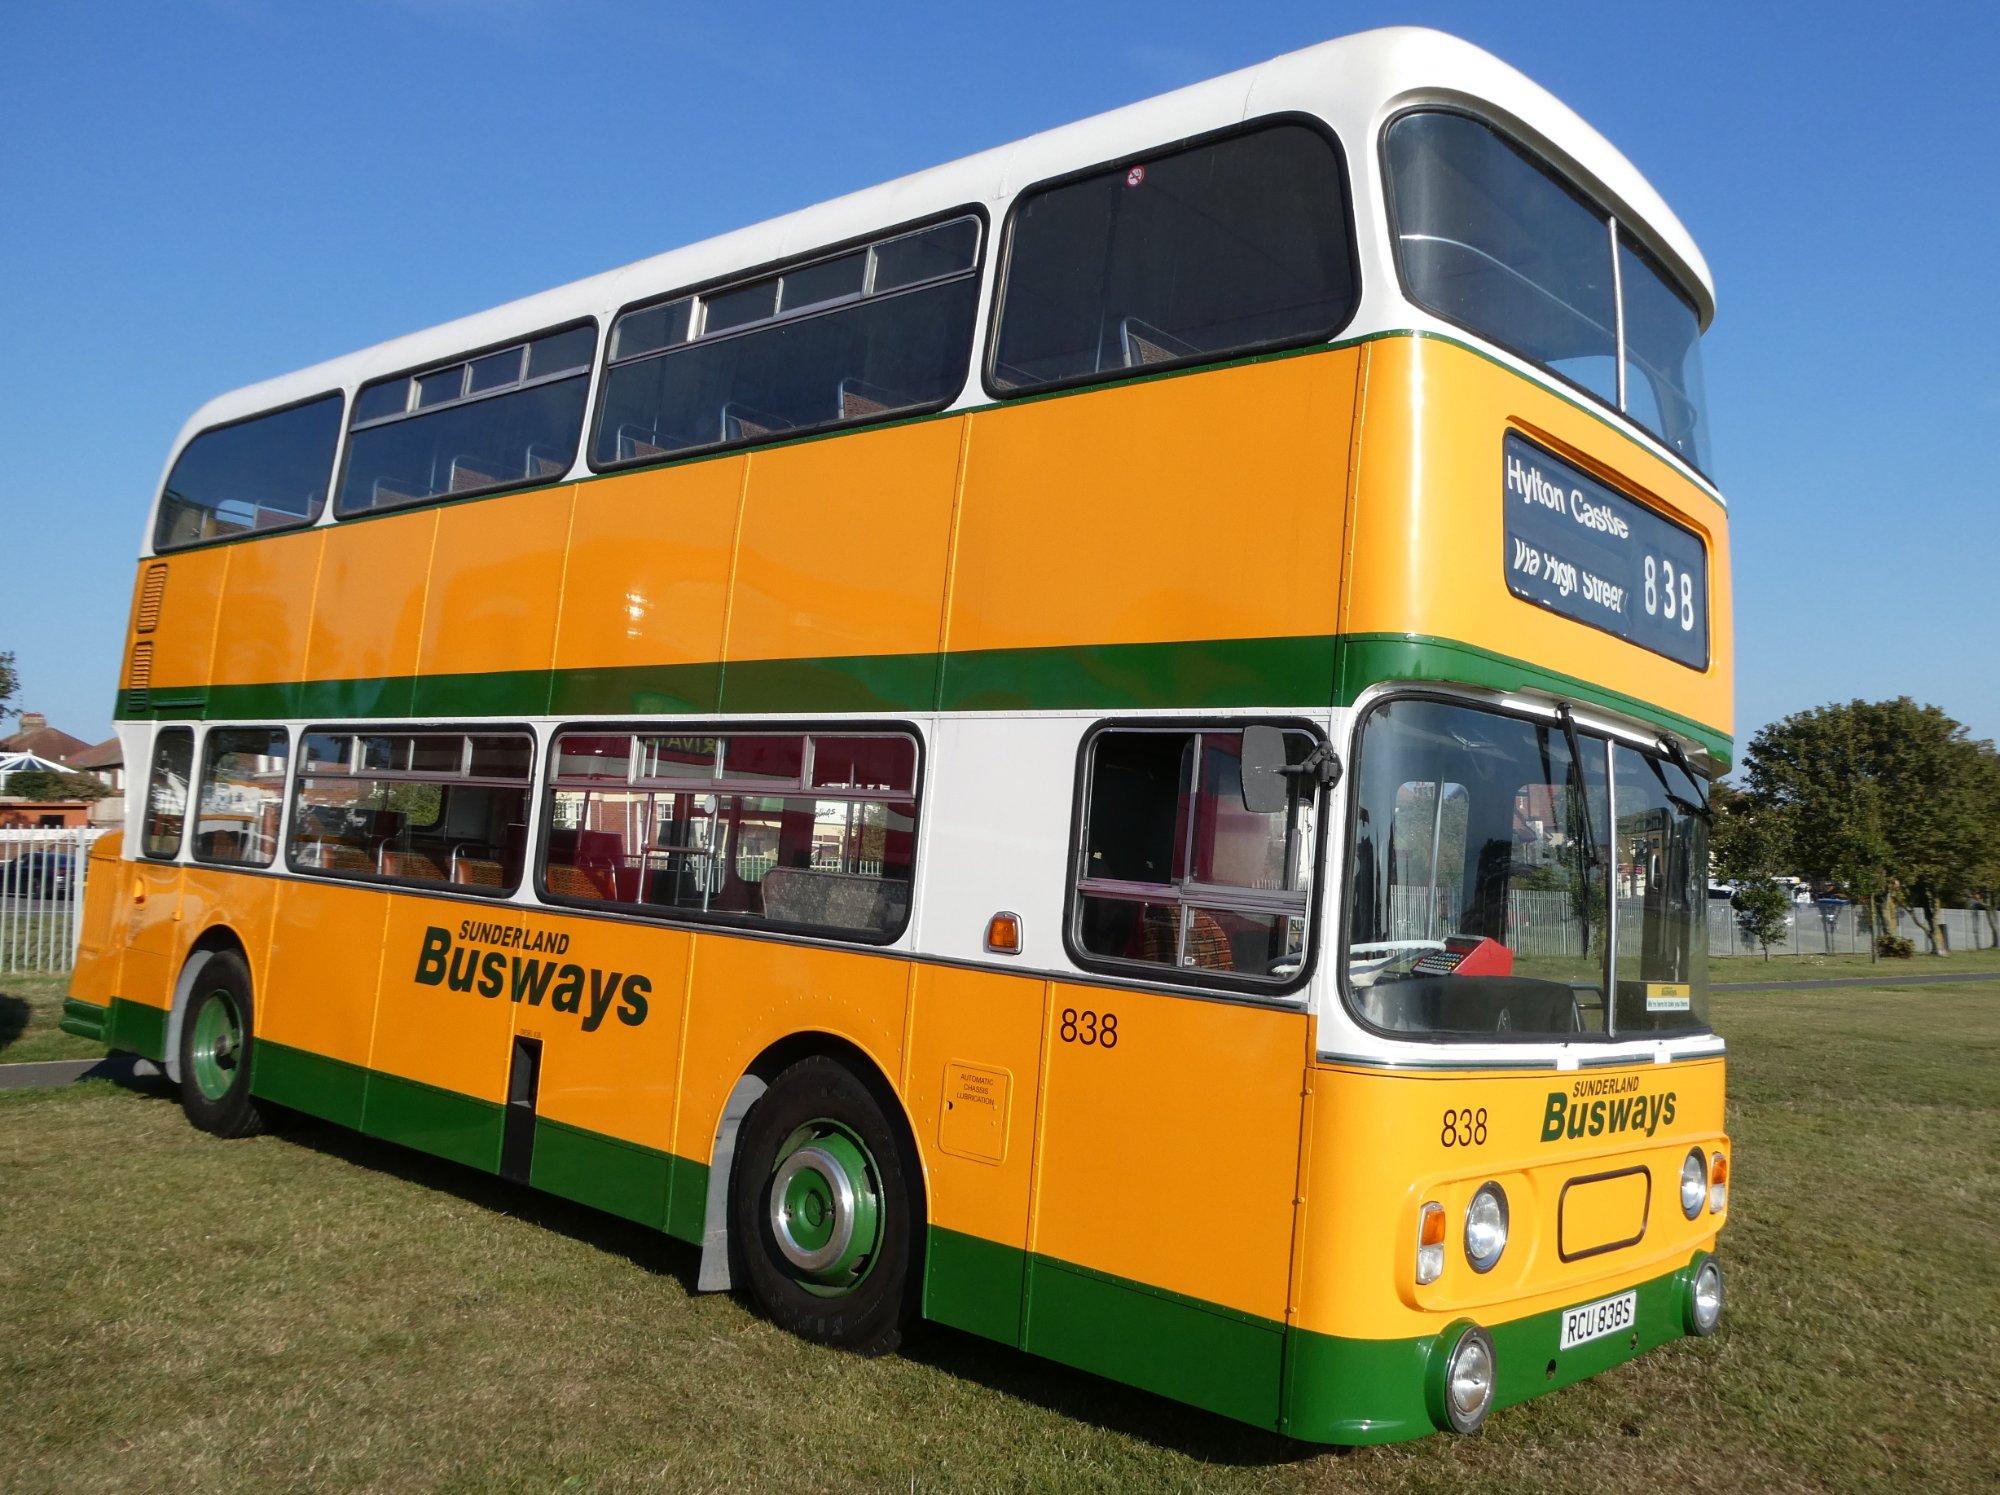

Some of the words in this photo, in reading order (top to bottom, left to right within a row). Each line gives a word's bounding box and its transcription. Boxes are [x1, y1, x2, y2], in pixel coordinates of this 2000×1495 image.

[1507, 455, 1565, 514] Hylton
[1571, 489, 1629, 539] Castle
[1513, 538, 1540, 576] Via
[1644, 555, 1694, 631] 838
[458, 920, 570, 955] SUNDERLAND
[414, 926, 653, 1032] Busways
[1060, 1008, 1118, 1048] 838
[956, 1092, 995, 1106] LUBRICATION
[960, 1073, 994, 1086] AUTOMATIC
[963, 1083, 989, 1095] CHASSIS
[1572, 1076, 1639, 1098] SUNDERLAND
[1441, 1108, 1488, 1147] 838
[1540, 1092, 1676, 1142] Busways
[1568, 1309, 1595, 1343] RCU
[1597, 1298, 1631, 1333] 838S
